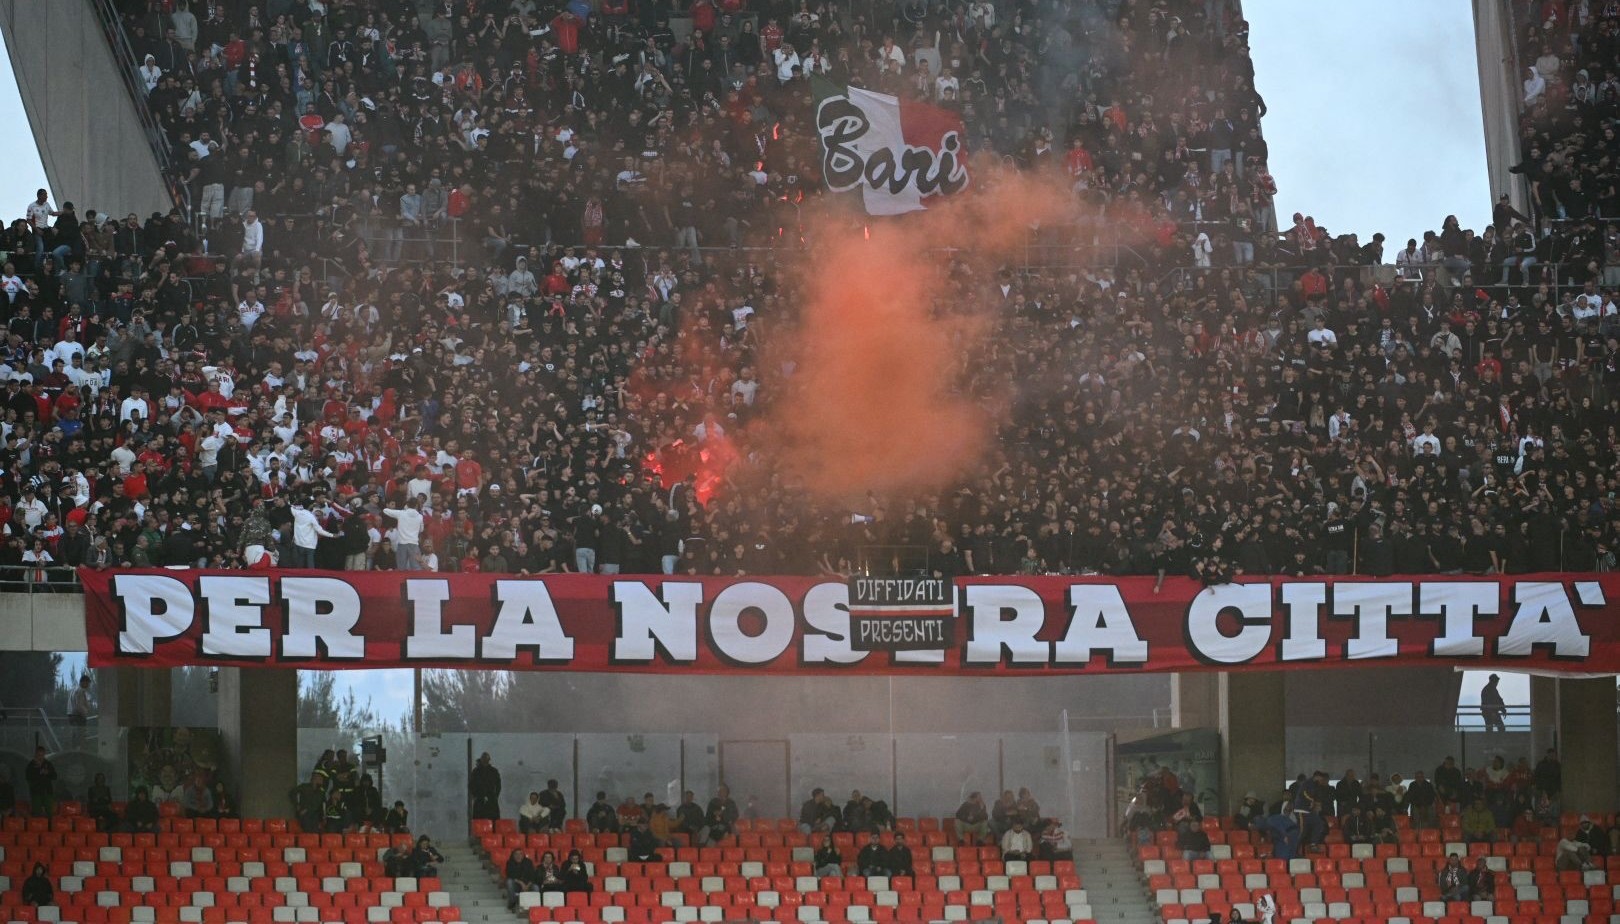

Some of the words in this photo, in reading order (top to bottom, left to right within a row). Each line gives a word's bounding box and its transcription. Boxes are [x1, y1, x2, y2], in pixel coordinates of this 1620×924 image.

[816, 95, 968, 197] Bari
[856, 579, 944, 601] DIFFIDATI
[112, 573, 366, 659] PER
[405, 577, 575, 661] LA
[612, 580, 1149, 667] NOSRA
[860, 619, 944, 643] PRESENTI
